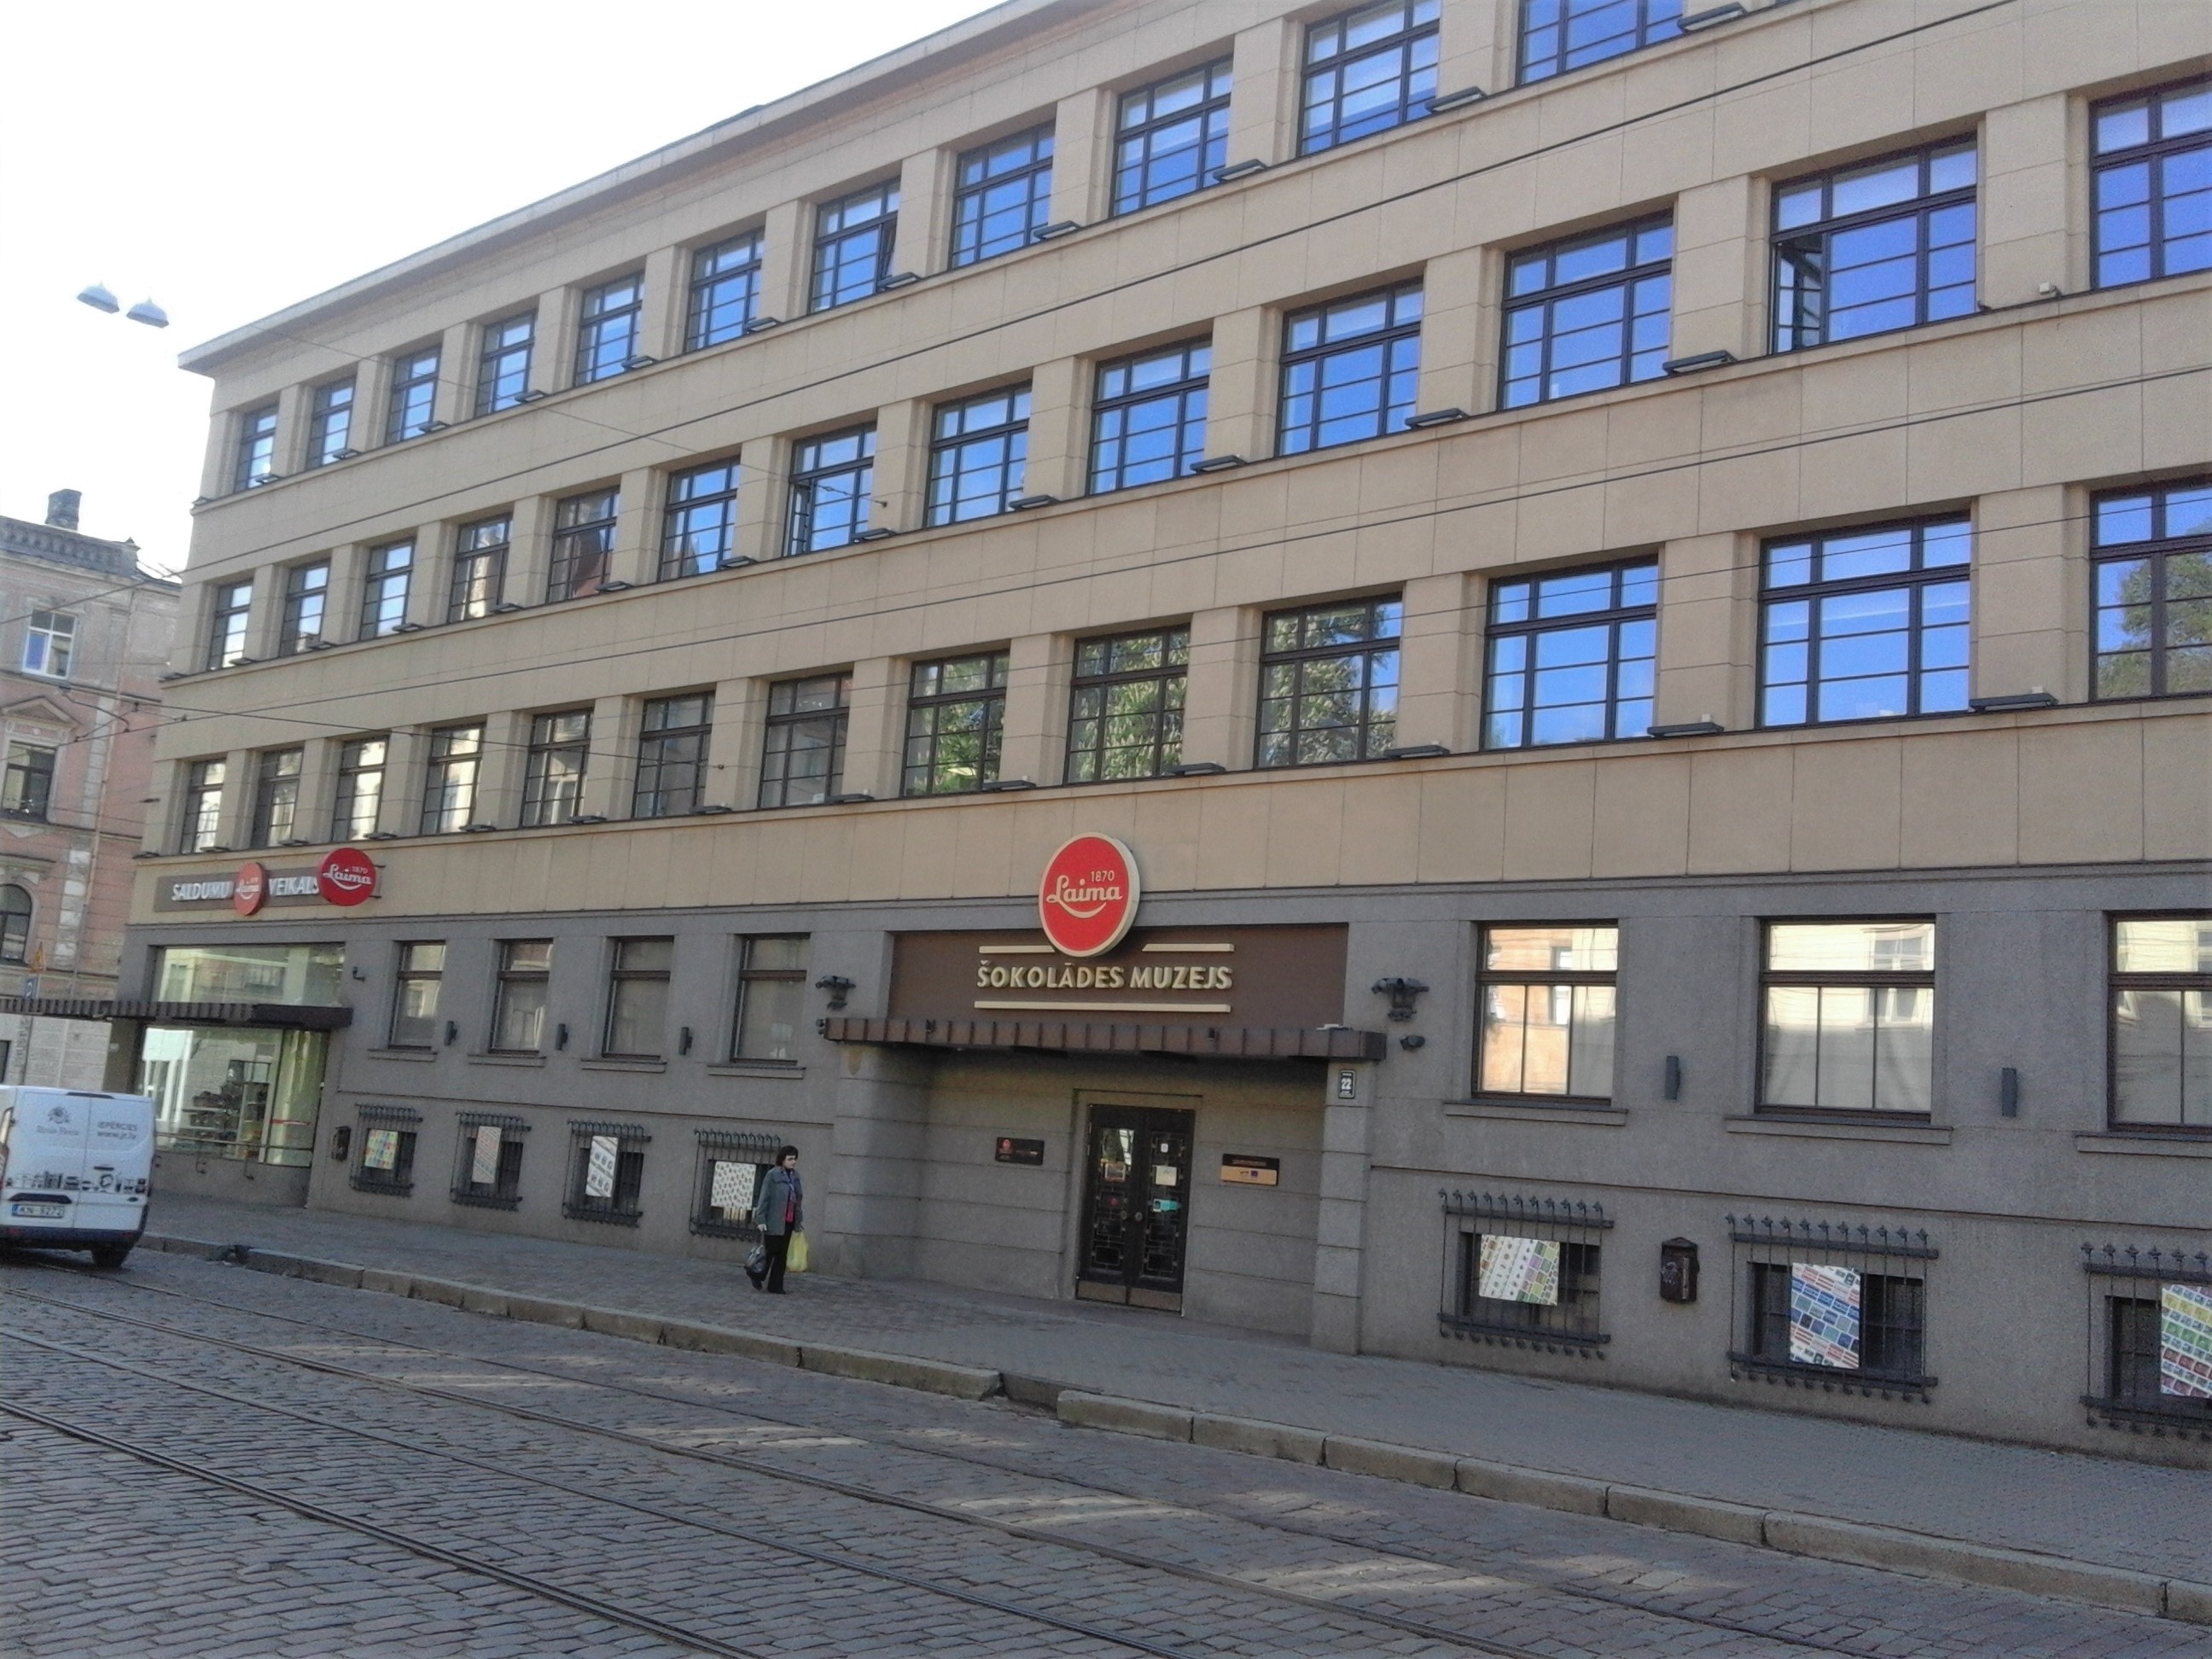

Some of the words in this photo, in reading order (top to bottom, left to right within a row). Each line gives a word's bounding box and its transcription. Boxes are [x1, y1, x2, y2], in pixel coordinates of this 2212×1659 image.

[323, 864, 371, 890] Laima
[1091, 870, 1115, 882] 1870
[1046, 875, 1123, 918] Laima
[976, 960, 1125, 989] ŠOKOLĀDES
[1129, 965, 1234, 990] MUZEJS
[1341, 1077, 1352, 1091] 22
